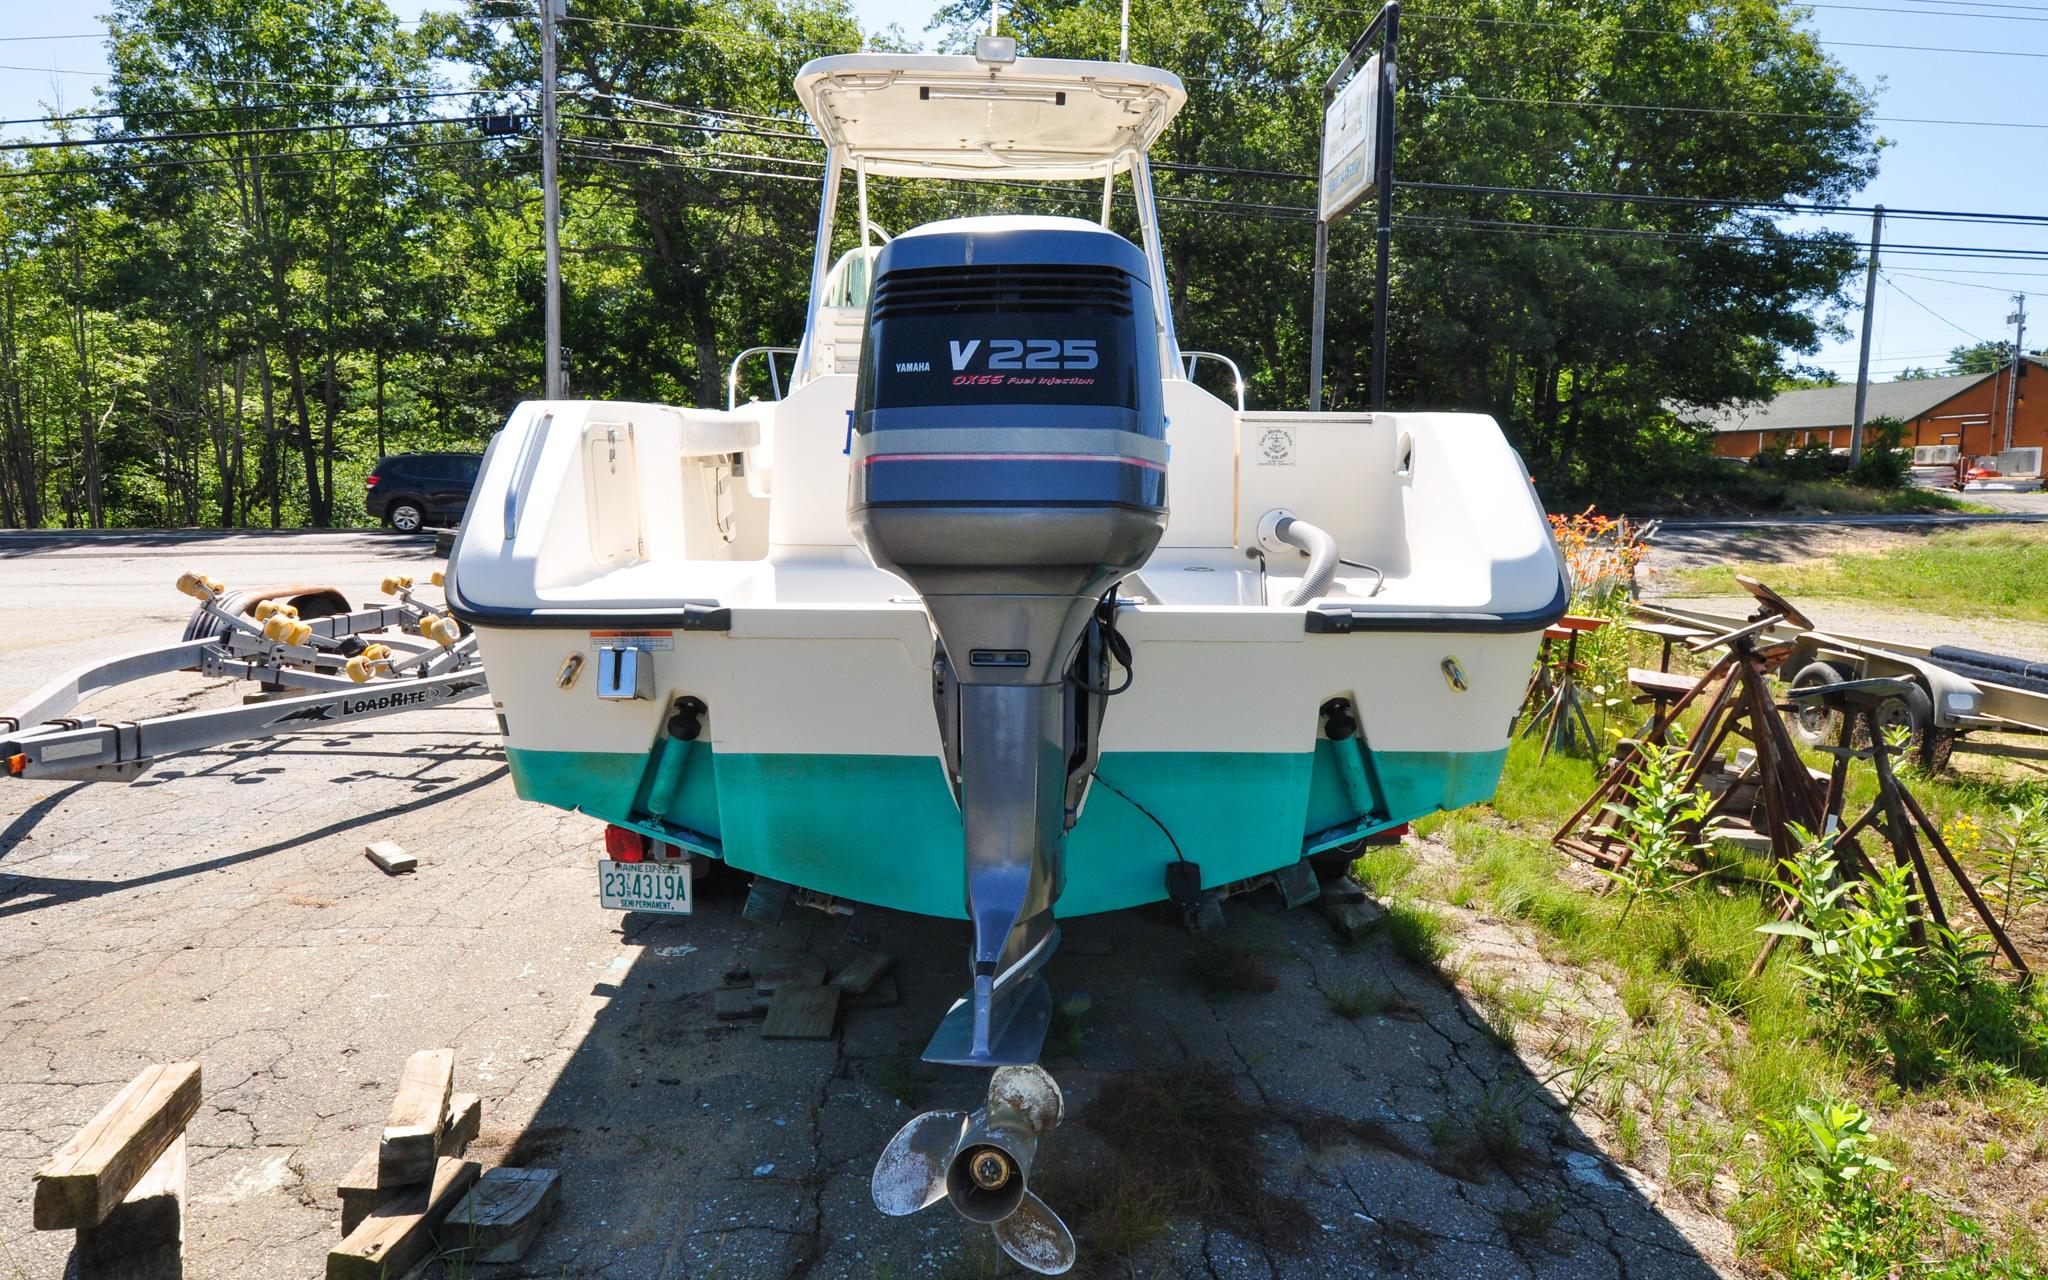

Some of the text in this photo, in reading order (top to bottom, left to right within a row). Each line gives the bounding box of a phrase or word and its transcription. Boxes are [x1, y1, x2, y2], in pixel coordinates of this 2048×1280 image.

[949, 339, 1099, 371] V 225
[896, 362, 930, 373] YAMAHA
[1007, 377, 1035, 385] Fuel
[1037, 377, 1094, 386] Injection
[605, 872, 626, 898] 23
[632, 873, 686, 901] 4319A
[620, 900, 671, 910] SEMI PERMANENT
